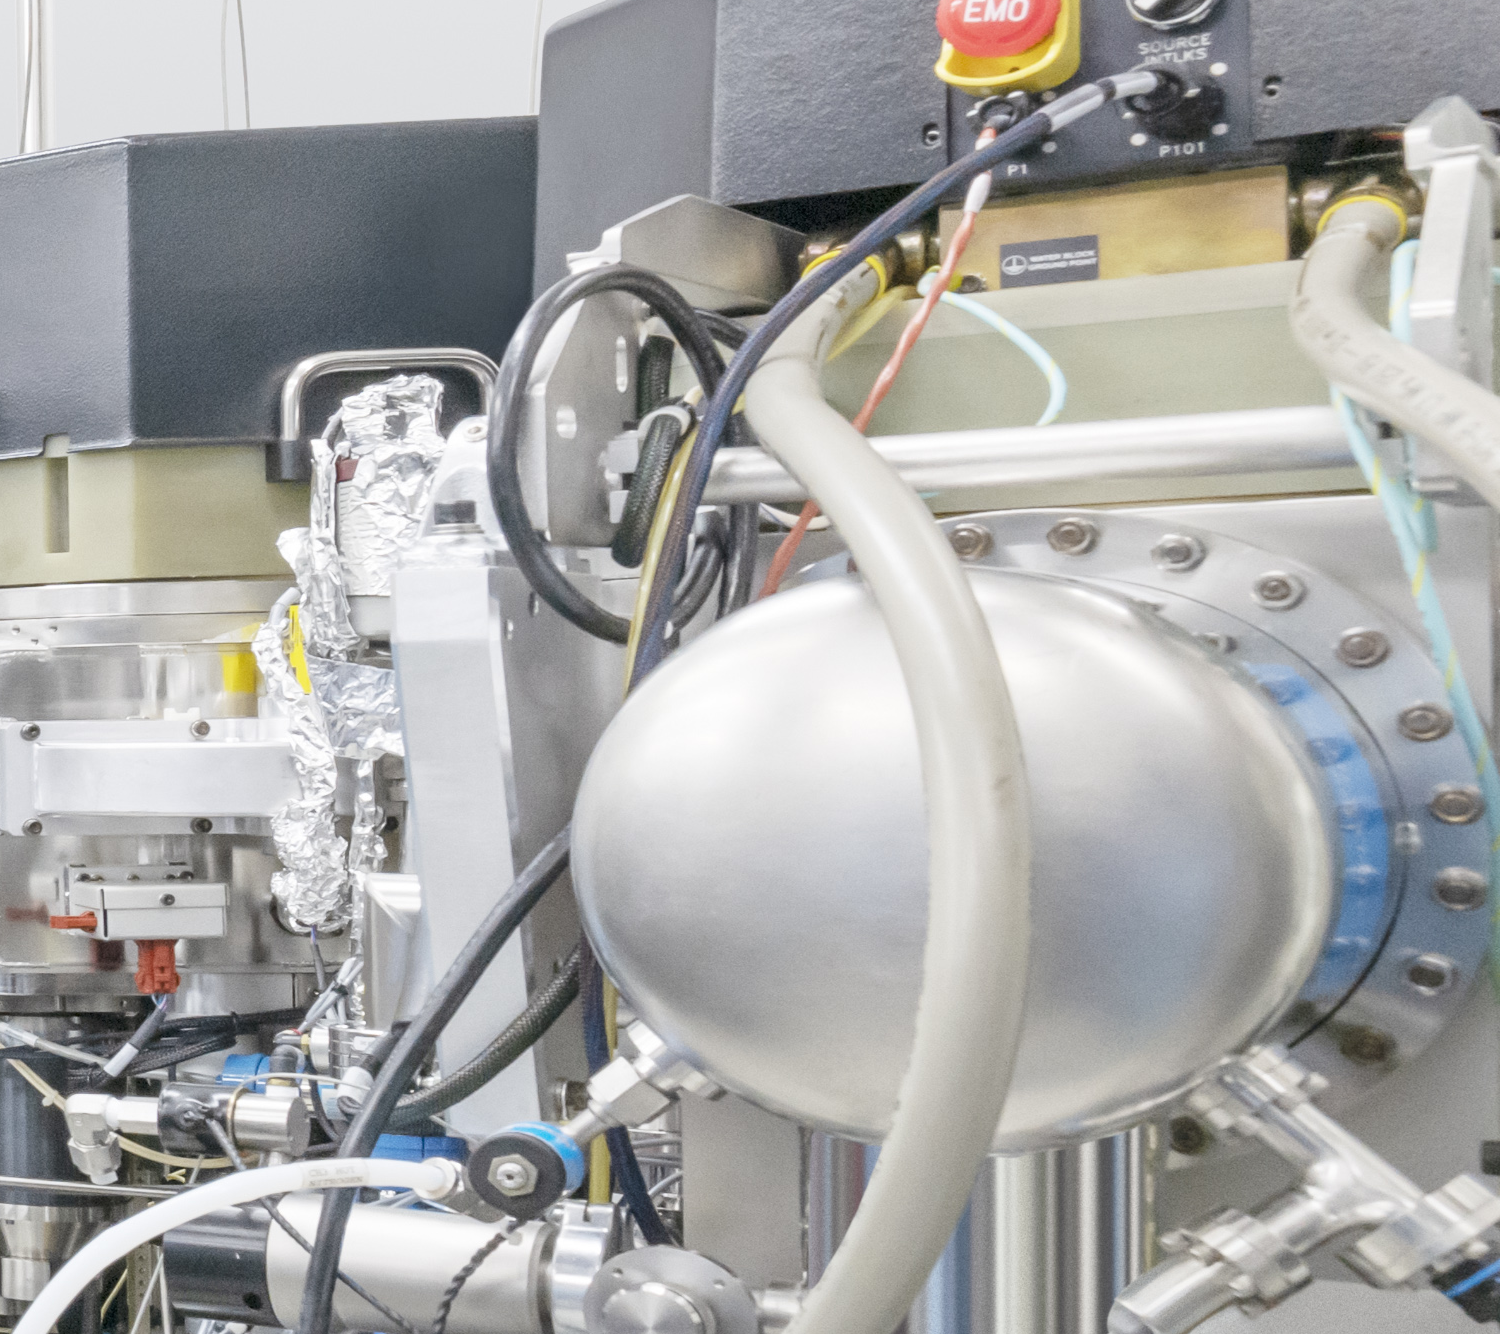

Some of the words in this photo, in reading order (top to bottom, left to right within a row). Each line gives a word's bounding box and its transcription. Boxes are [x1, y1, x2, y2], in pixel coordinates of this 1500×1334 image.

[1137, 32, 1212, 55] SOURCE
[1159, 142, 1205, 158] P101
[1007, 164, 1027, 176] P1
